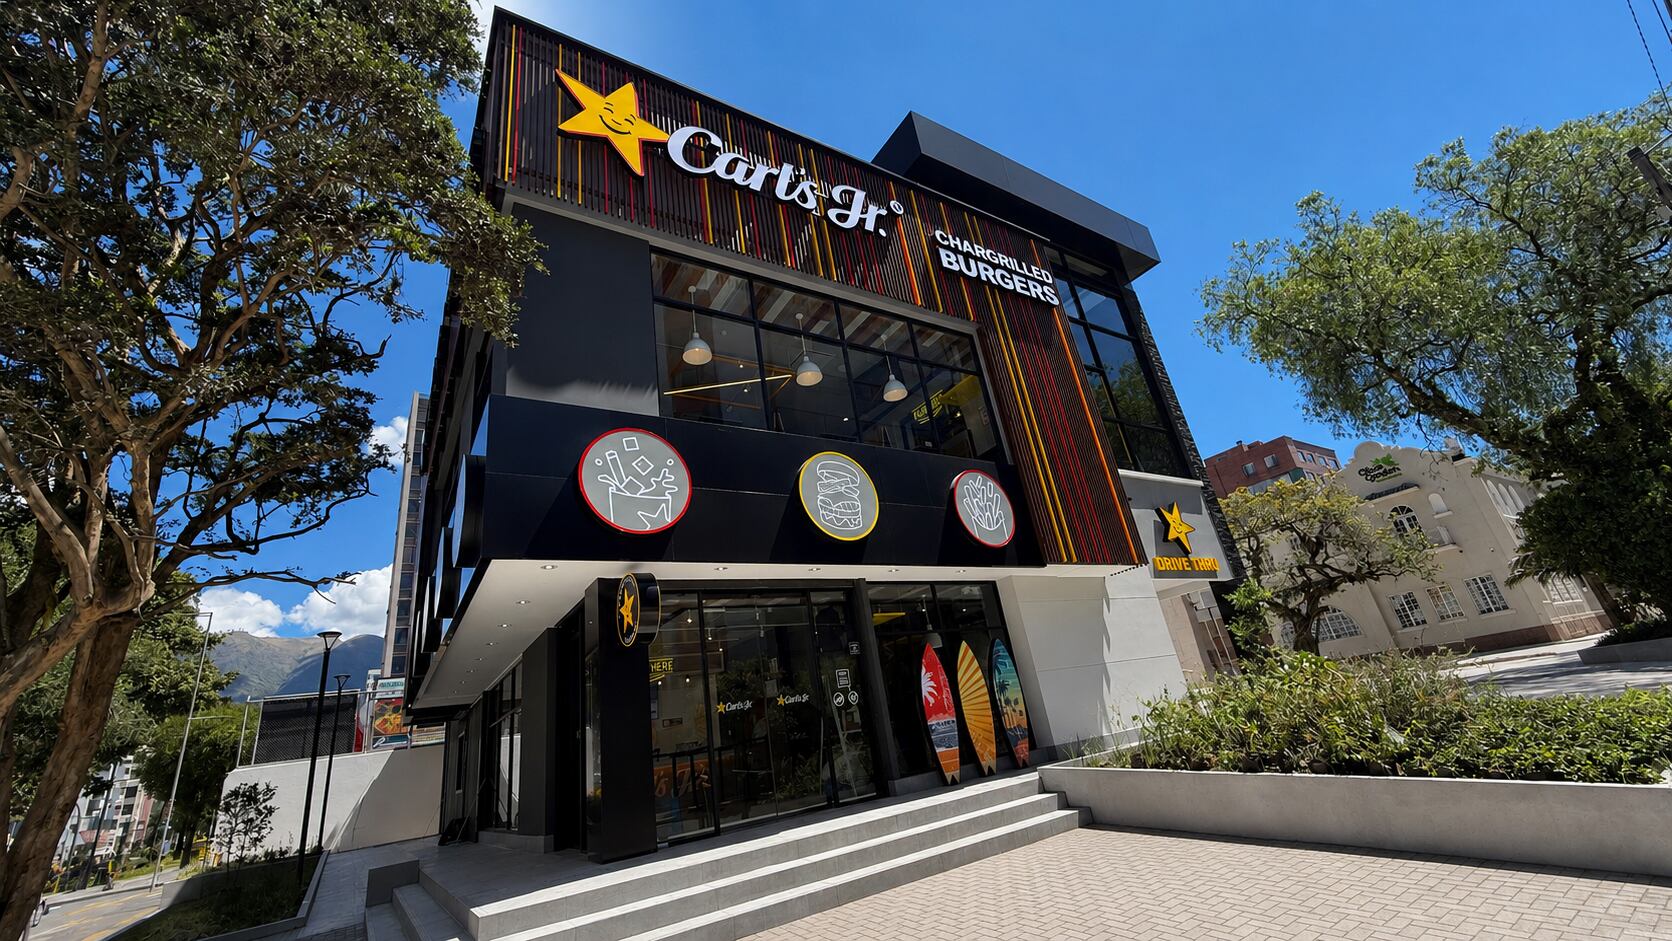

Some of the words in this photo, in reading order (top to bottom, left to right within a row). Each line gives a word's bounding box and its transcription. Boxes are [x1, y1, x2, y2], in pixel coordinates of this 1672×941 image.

[667, 126, 818, 210] Carl's
[934, 229, 1053, 284] CHARGRILLED
[938, 247, 1060, 306] BURGERS
[1153, 556, 1191, 571] DRIVE
[1190, 557, 1220, 571] THRU
